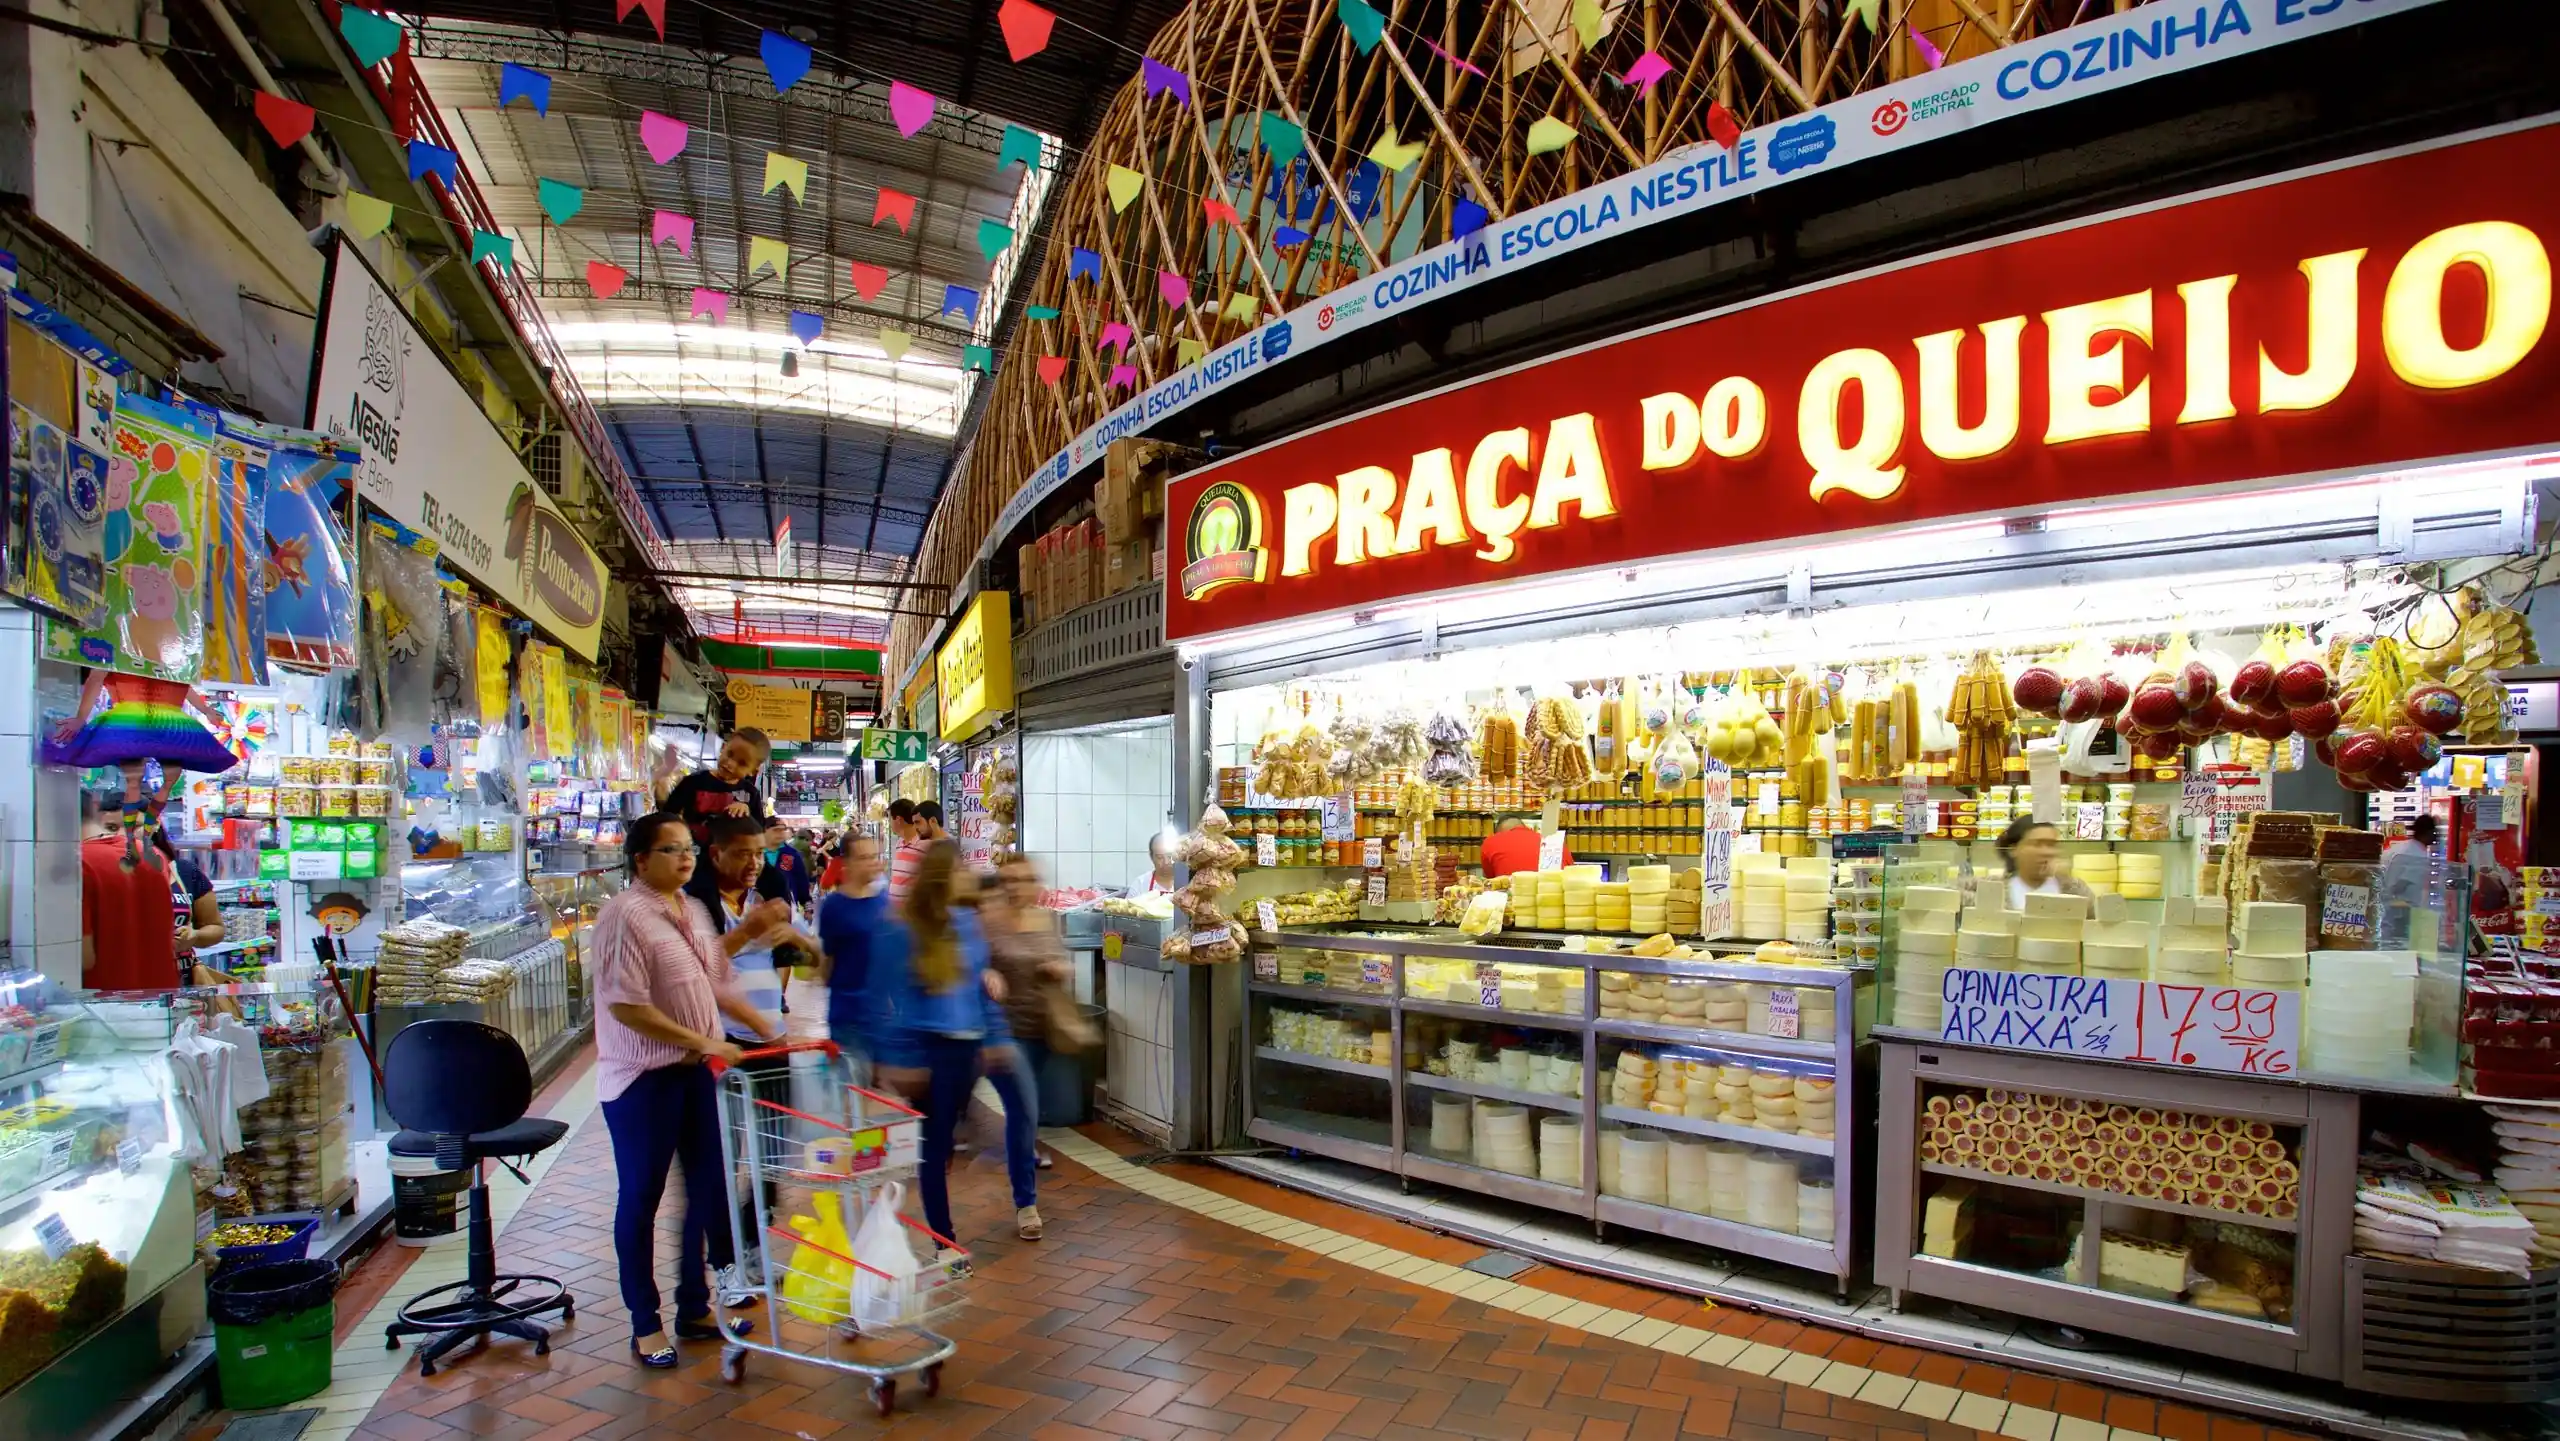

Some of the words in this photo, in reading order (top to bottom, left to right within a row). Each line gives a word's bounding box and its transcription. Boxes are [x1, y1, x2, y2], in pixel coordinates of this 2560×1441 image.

[1996, 0, 2252, 100] COZINHA
[1911, 81, 1981, 111] MERCADO
[1911, 96, 1975, 122] CENTRAL
[1373, 242, 1492, 310] COZINHA
[1501, 195, 1621, 263] ESCOLA
[1335, 294, 1368, 314] MERCADO
[1335, 304, 1366, 323] CENTRAL
[1095, 411, 1146, 450] COZINHA
[1147, 375, 1199, 418] ESCOLA
[1280, 411, 1617, 577] PRAÇA
[1640, 375, 1766, 471] DO
[1796, 218, 2554, 504] QUEIJO
[367, 458, 394, 501] Bem
[444, 512, 494, 573] 3274.9399
[538, 523, 596, 617] Bomcacau
[2214, 795, 2267, 803] ENDIMENTO
[2214, 803, 2266, 811] FERENCIAL
[1942, 967, 2108, 1018] CANASTRA
[1943, 1003, 2080, 1050] ARAXÁ
[2241, 1046, 2292, 1073] KG
